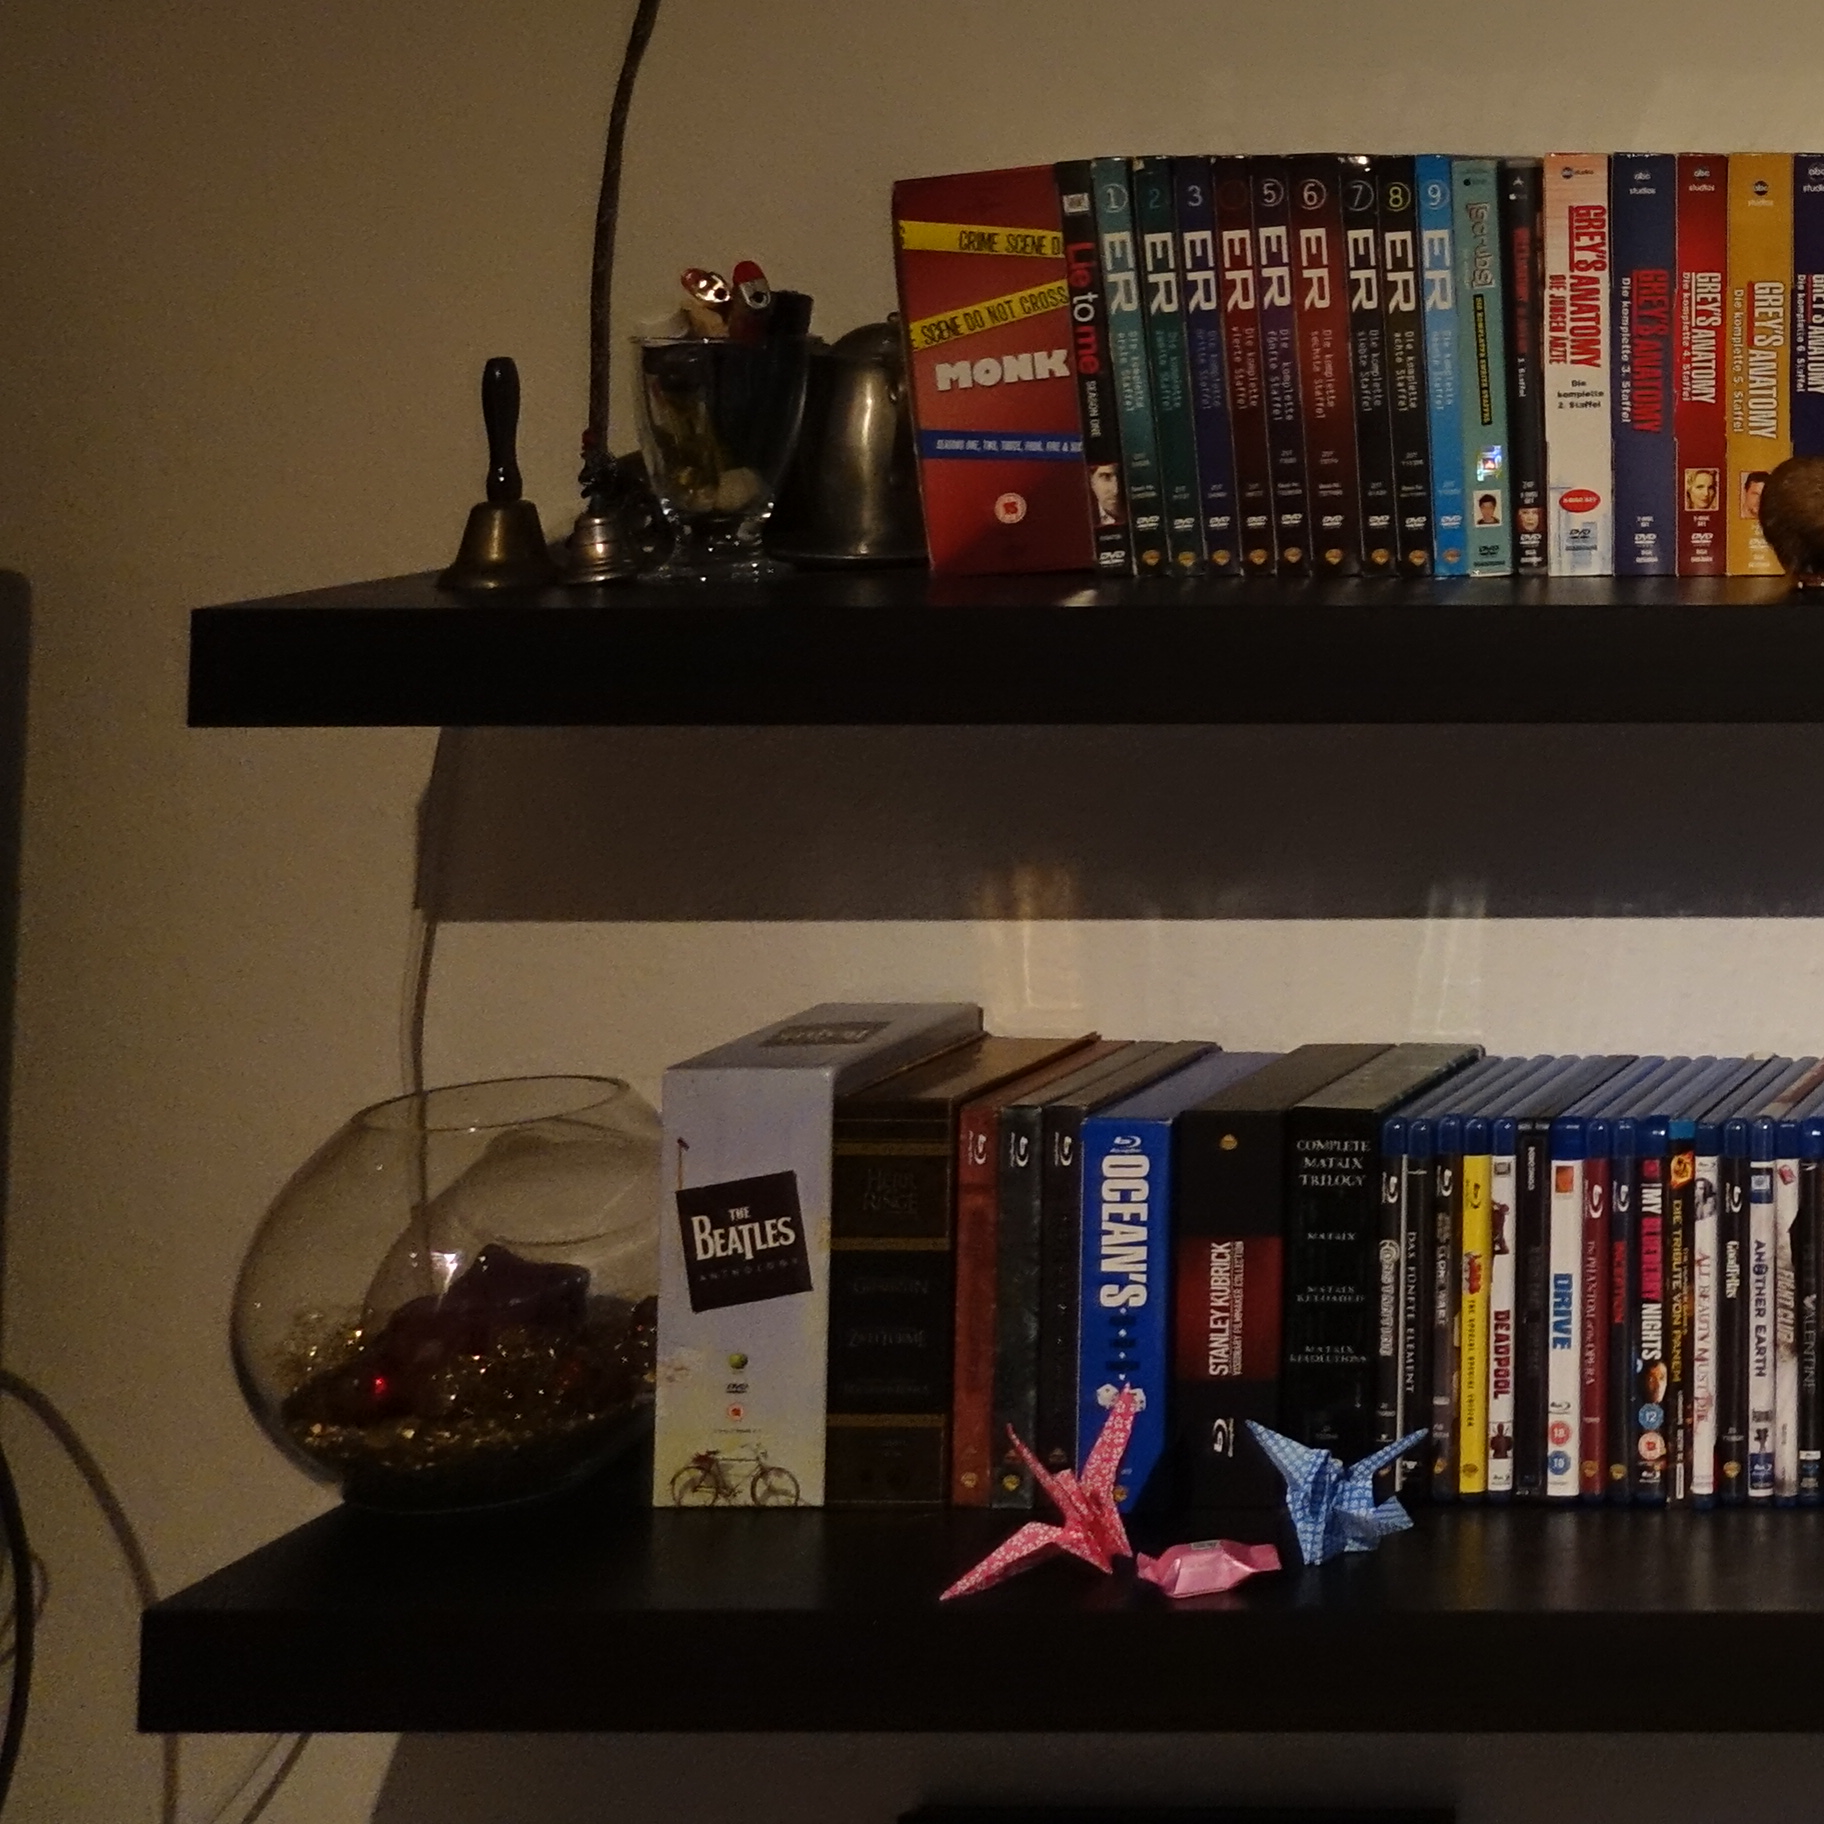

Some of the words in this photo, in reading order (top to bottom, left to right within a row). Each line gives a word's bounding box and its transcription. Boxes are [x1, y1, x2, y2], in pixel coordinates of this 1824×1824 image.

[959, 229, 997, 252] CRIME
[1007, 236, 1046, 255] SCENE
[1183, 229, 1219, 313] ER
[1260, 226, 1293, 309] ER
[1300, 227, 1331, 310] ER
[1347, 228, 1378, 313] ER
[1421, 229, 1453, 313] ER
[1570, 206, 1608, 271] GREY'S
[1103, 232, 1140, 315] ER
[1694, 271, 1721, 319] GREY'S
[922, 318, 963, 344] SCENE
[966, 311, 986, 334] DO
[989, 303, 1015, 328] NOT
[1020, 287, 1068, 318] CROSS
[1071, 291, 1096, 324] to
[1569, 275, 1607, 369] ANATOMY
[935, 349, 1070, 391] MONK
[1074, 324, 1101, 374] me
[1690, 322, 1721, 405] ANATOMY
[1296, 1138, 1371, 1154] COMPLETE
[1302, 1155, 1364, 1170] MATRIX
[1299, 1172, 1366, 1188] TRILOGY
[691, 1214, 796, 1264] BEATLES
[728, 1206, 751, 1221] THE
[1099, 1155, 1151, 1308] OCEAN'S
[1209, 1241, 1231, 1306] KUBRICK
[1209, 1310, 1229, 1376] STANLEY
[1552, 1273, 1573, 1350] DRIVE
[1493, 1309, 1511, 1400] DEADPOOL
[1754, 1325, 1768, 1378] EARTH
